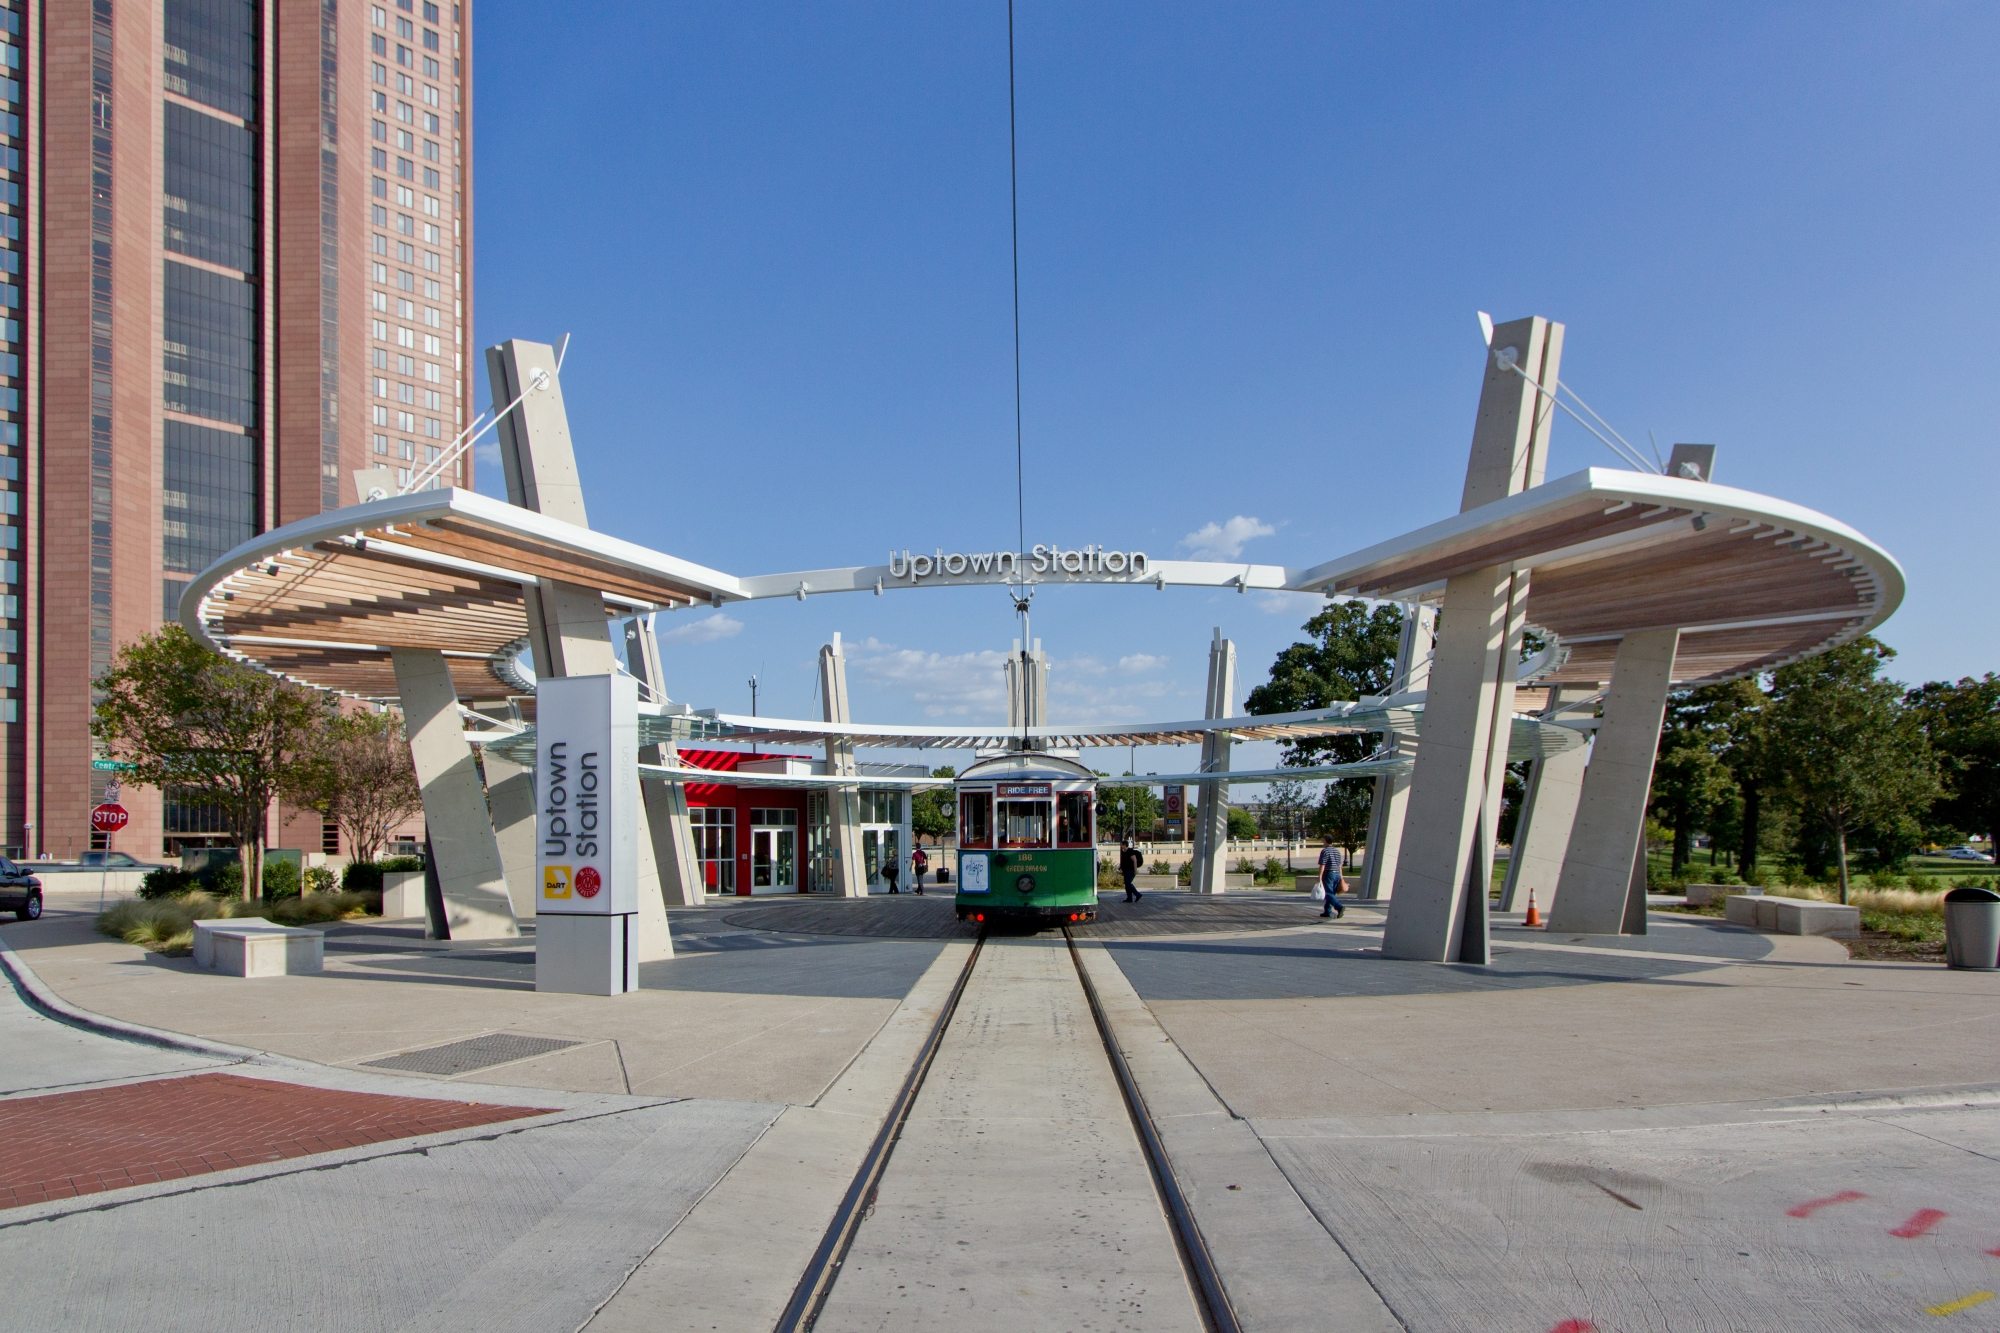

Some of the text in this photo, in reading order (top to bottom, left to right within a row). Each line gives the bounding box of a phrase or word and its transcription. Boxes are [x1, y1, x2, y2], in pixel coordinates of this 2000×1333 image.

[889, 544, 1149, 583] Uptown Station
[545, 741, 571, 856] Uptown
[575, 752, 598, 858] Station
[1007, 786, 1049, 794] RIDE FREE
[93, 811, 127, 824] STOP
